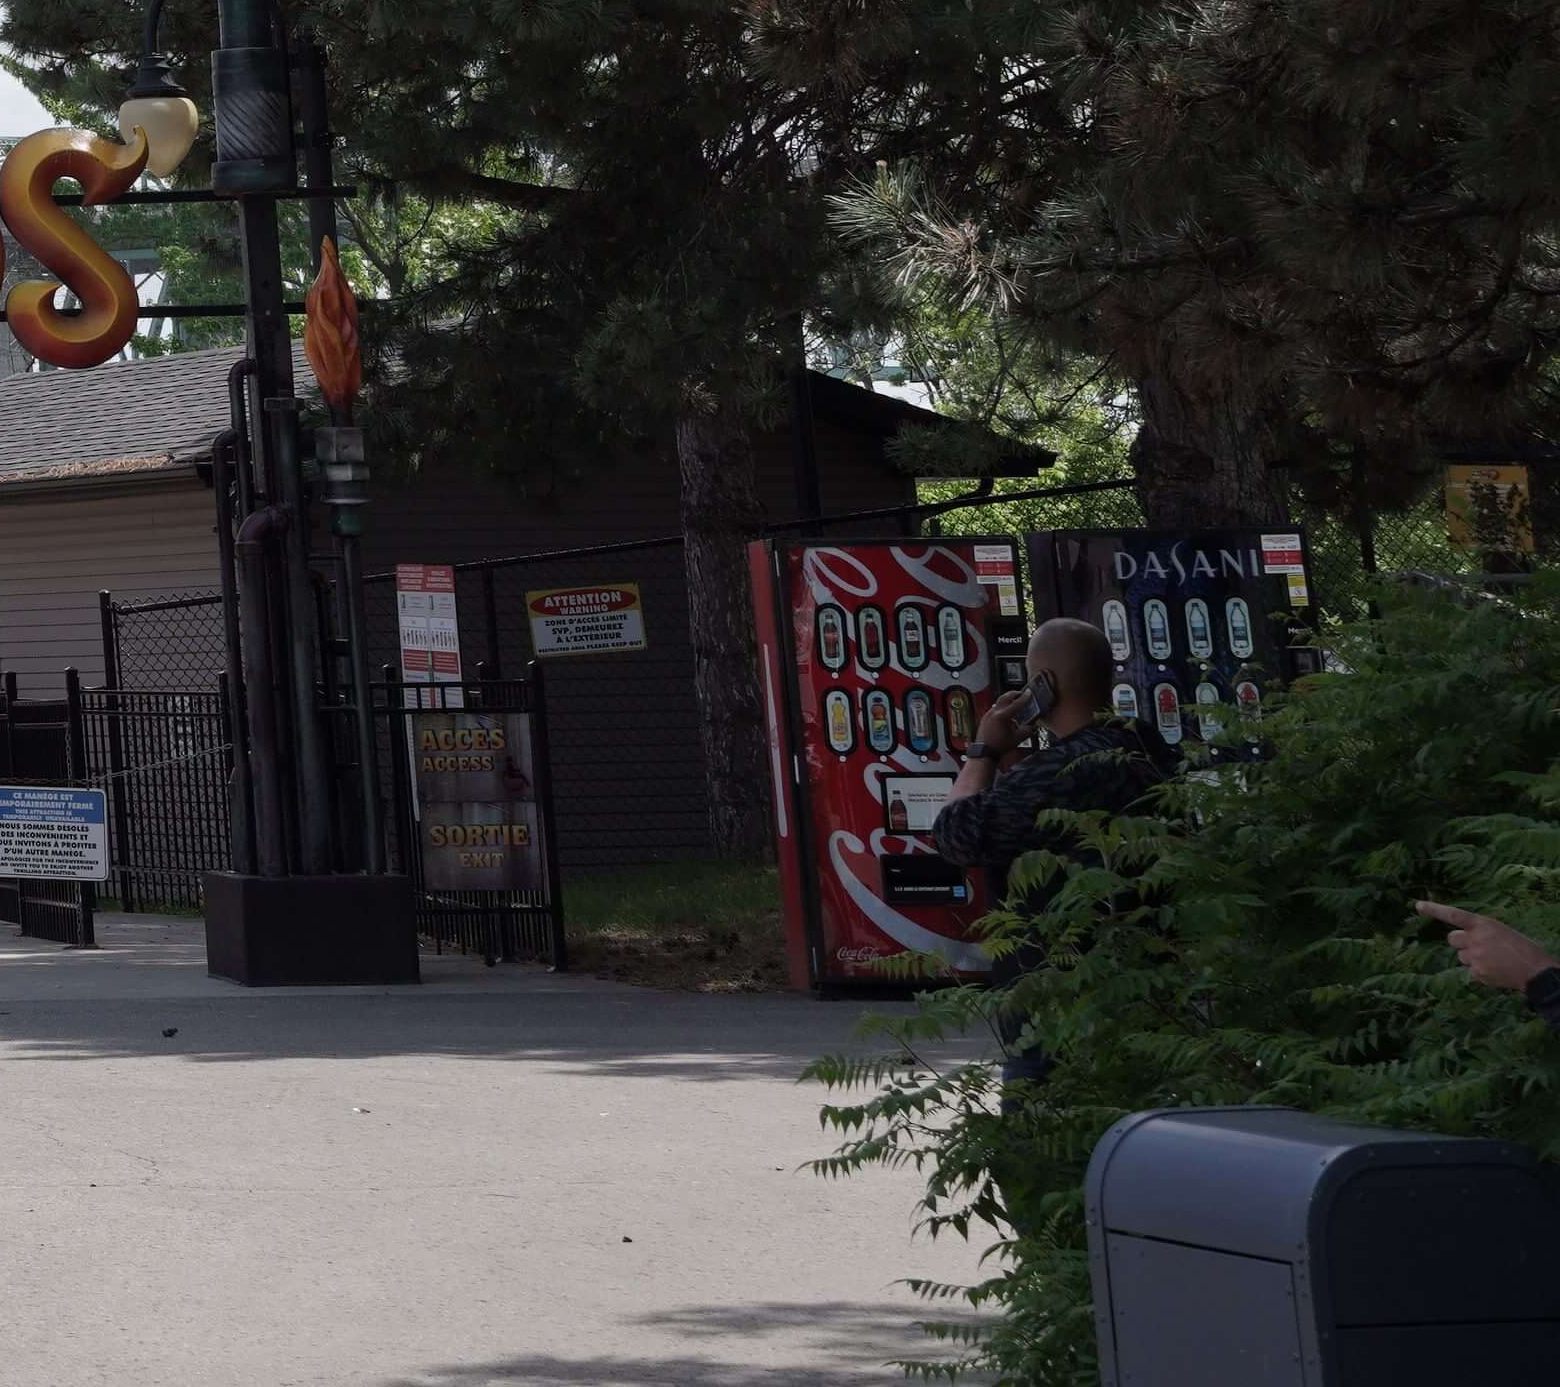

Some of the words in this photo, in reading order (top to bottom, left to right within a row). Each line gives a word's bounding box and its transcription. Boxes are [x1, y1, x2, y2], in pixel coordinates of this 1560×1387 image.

[1112, 540, 1260, 587] DASANI
[544, 591, 622, 608] ATTENTION
[560, 604, 609, 615] WARNING
[545, 618, 566, 627] ZONE
[575, 623, 624, 633] DEMEUREZ
[997, 636, 1023, 644] Merci!
[422, 756, 495, 772] ACCESS
[13, 792, 22, 800] CE
[60, 793, 74, 801] EST
[0, 822, 20, 830] NOUS
[23, 823, 55, 831] SOMMES
[1, 830, 14, 838] DES
[430, 824, 531, 847] SORTIE
[15, 839, 52, 847] INVITONS
[53, 839, 59, 848] À
[61, 841, 97, 849] PROFITER
[25, 848, 49, 856] AUTRE
[458, 852, 505, 868] EXIT
